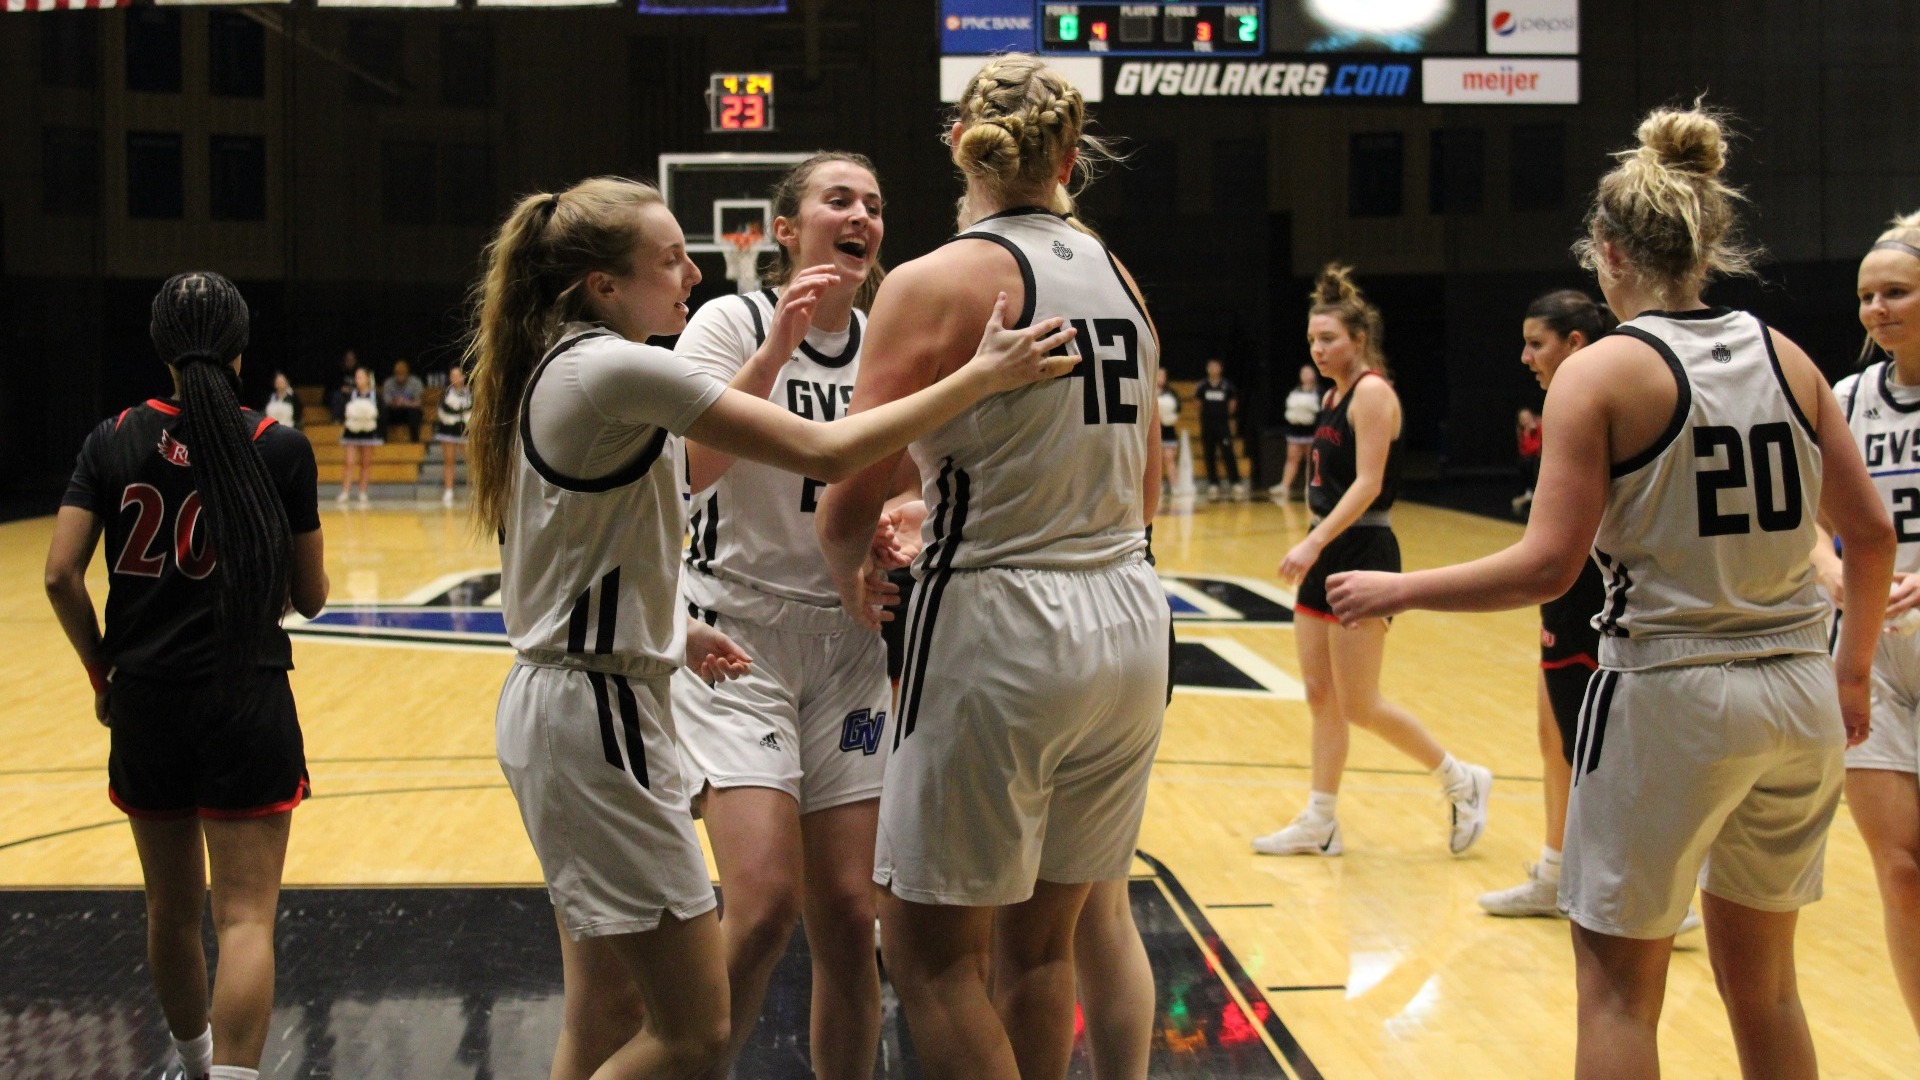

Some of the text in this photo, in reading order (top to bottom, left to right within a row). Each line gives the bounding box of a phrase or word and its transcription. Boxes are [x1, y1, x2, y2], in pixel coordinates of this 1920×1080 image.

[1196, 21, 1212, 42] 3
[1238, 15, 1258, 42] 2
[1114, 61, 1412, 97] GVSULAKERS.COM
[1462, 65, 1539, 97] meijer
[721, 95, 764, 129] 23
[1692, 421, 1803, 537] 20
[114, 482, 217, 581] 20
[839, 707, 886, 757] GV
